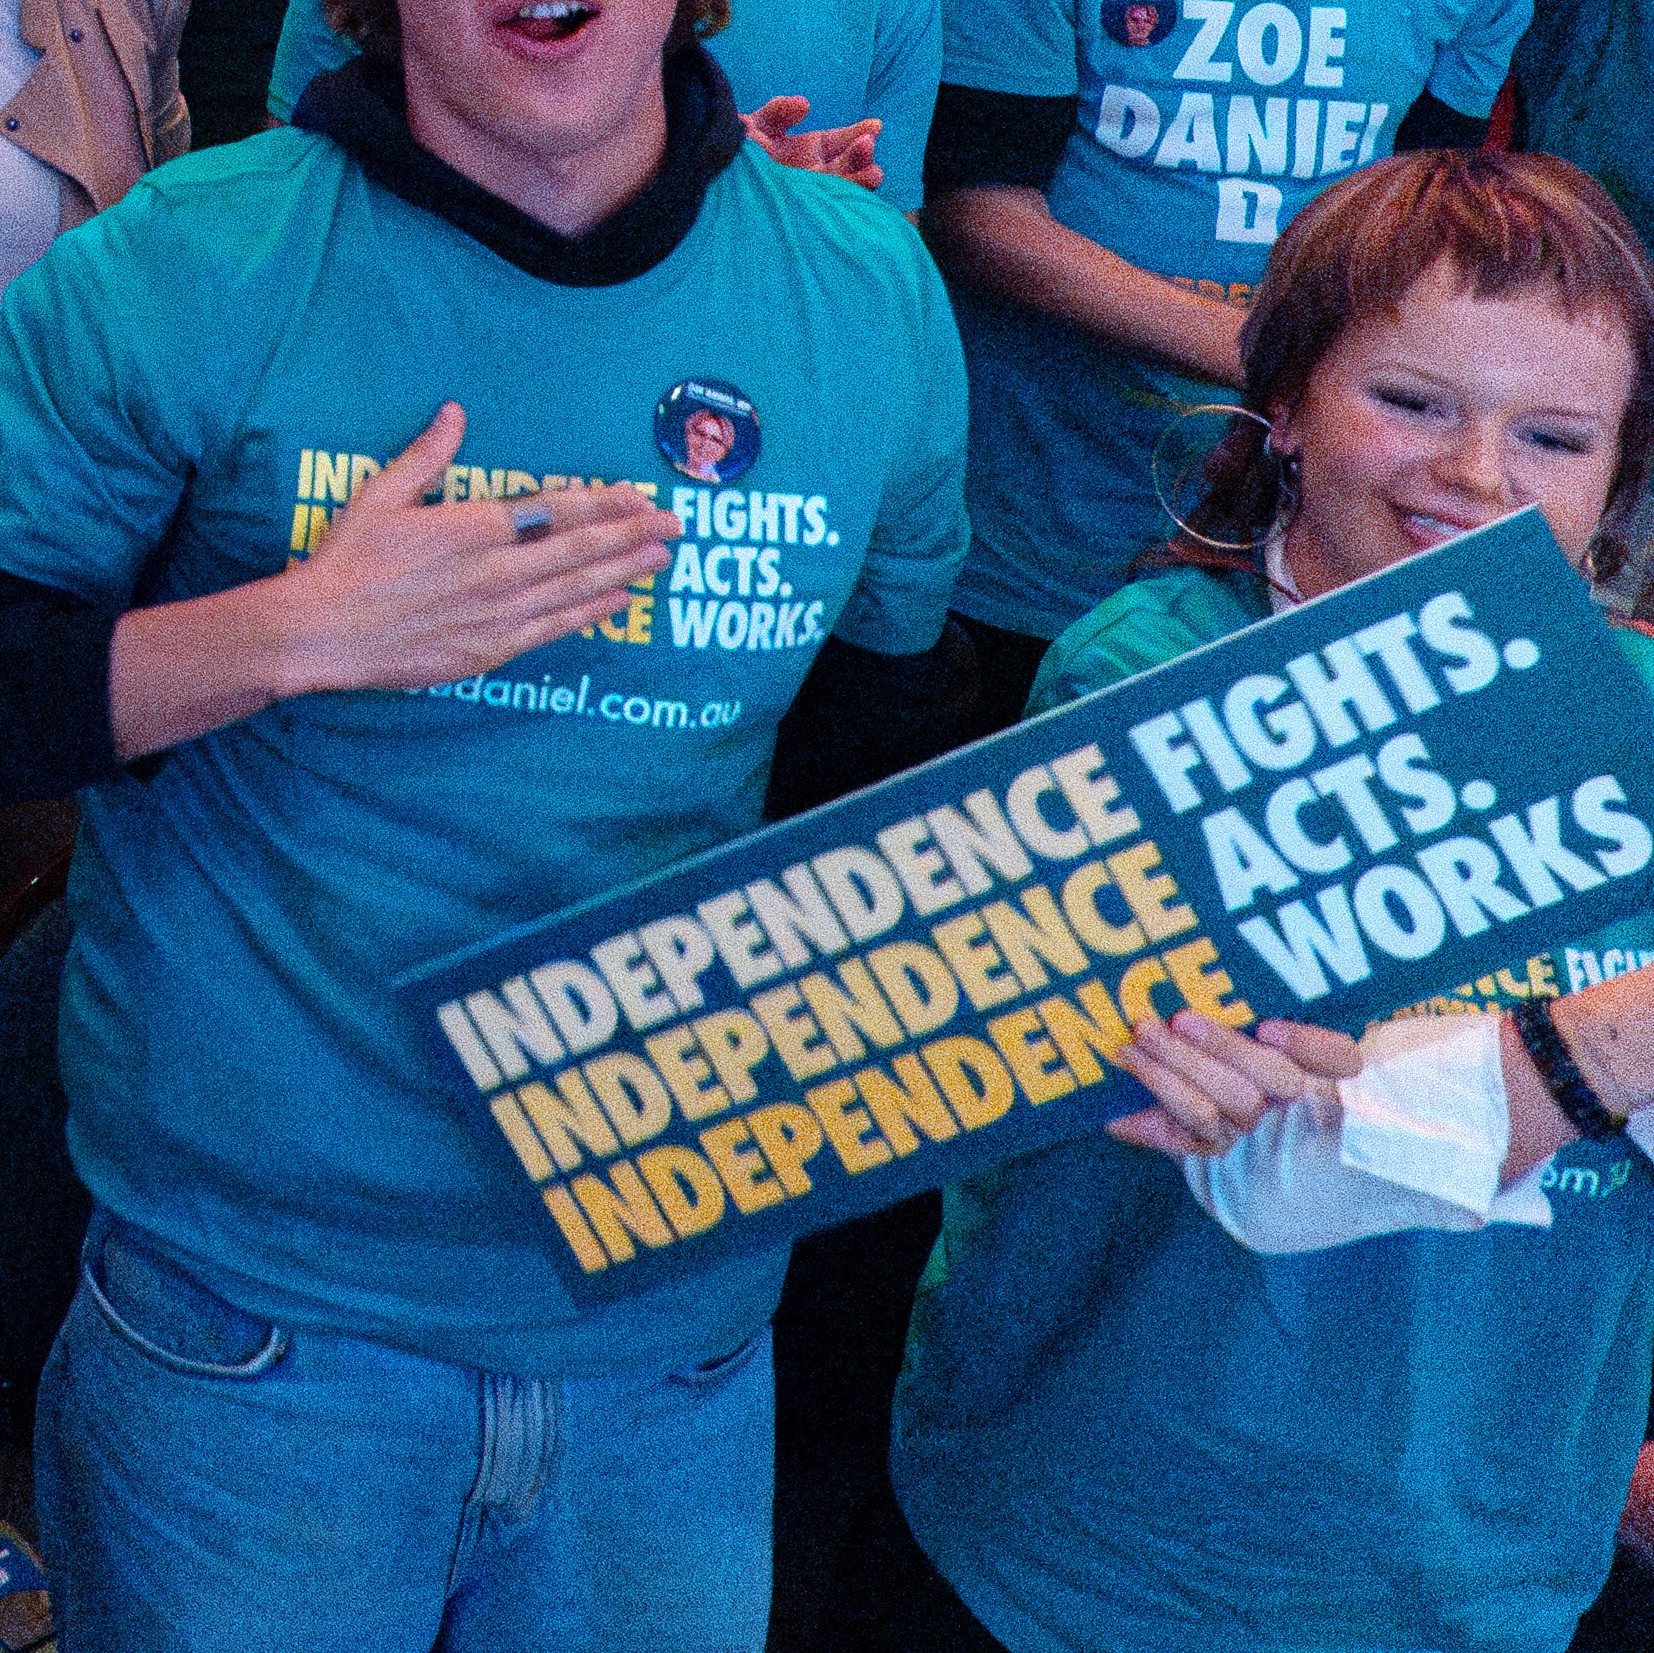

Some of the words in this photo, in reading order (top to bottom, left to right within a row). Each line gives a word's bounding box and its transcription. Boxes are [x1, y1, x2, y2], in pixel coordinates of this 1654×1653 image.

[670, 544, 792, 597] ACTS.
[671, 486, 840, 546] FIGHTS.
[669, 598, 823, 651] WORKS.
[437, 743, 1148, 1085] INDEPENDENCE
[1129, 590, 1540, 817] FIGHTS.
[488, 840, 1202, 1179] INDEPENDENCE
[1197, 733, 1495, 912] ACTS.
[539, 938, 1256, 1273] INDEPENDENCE
